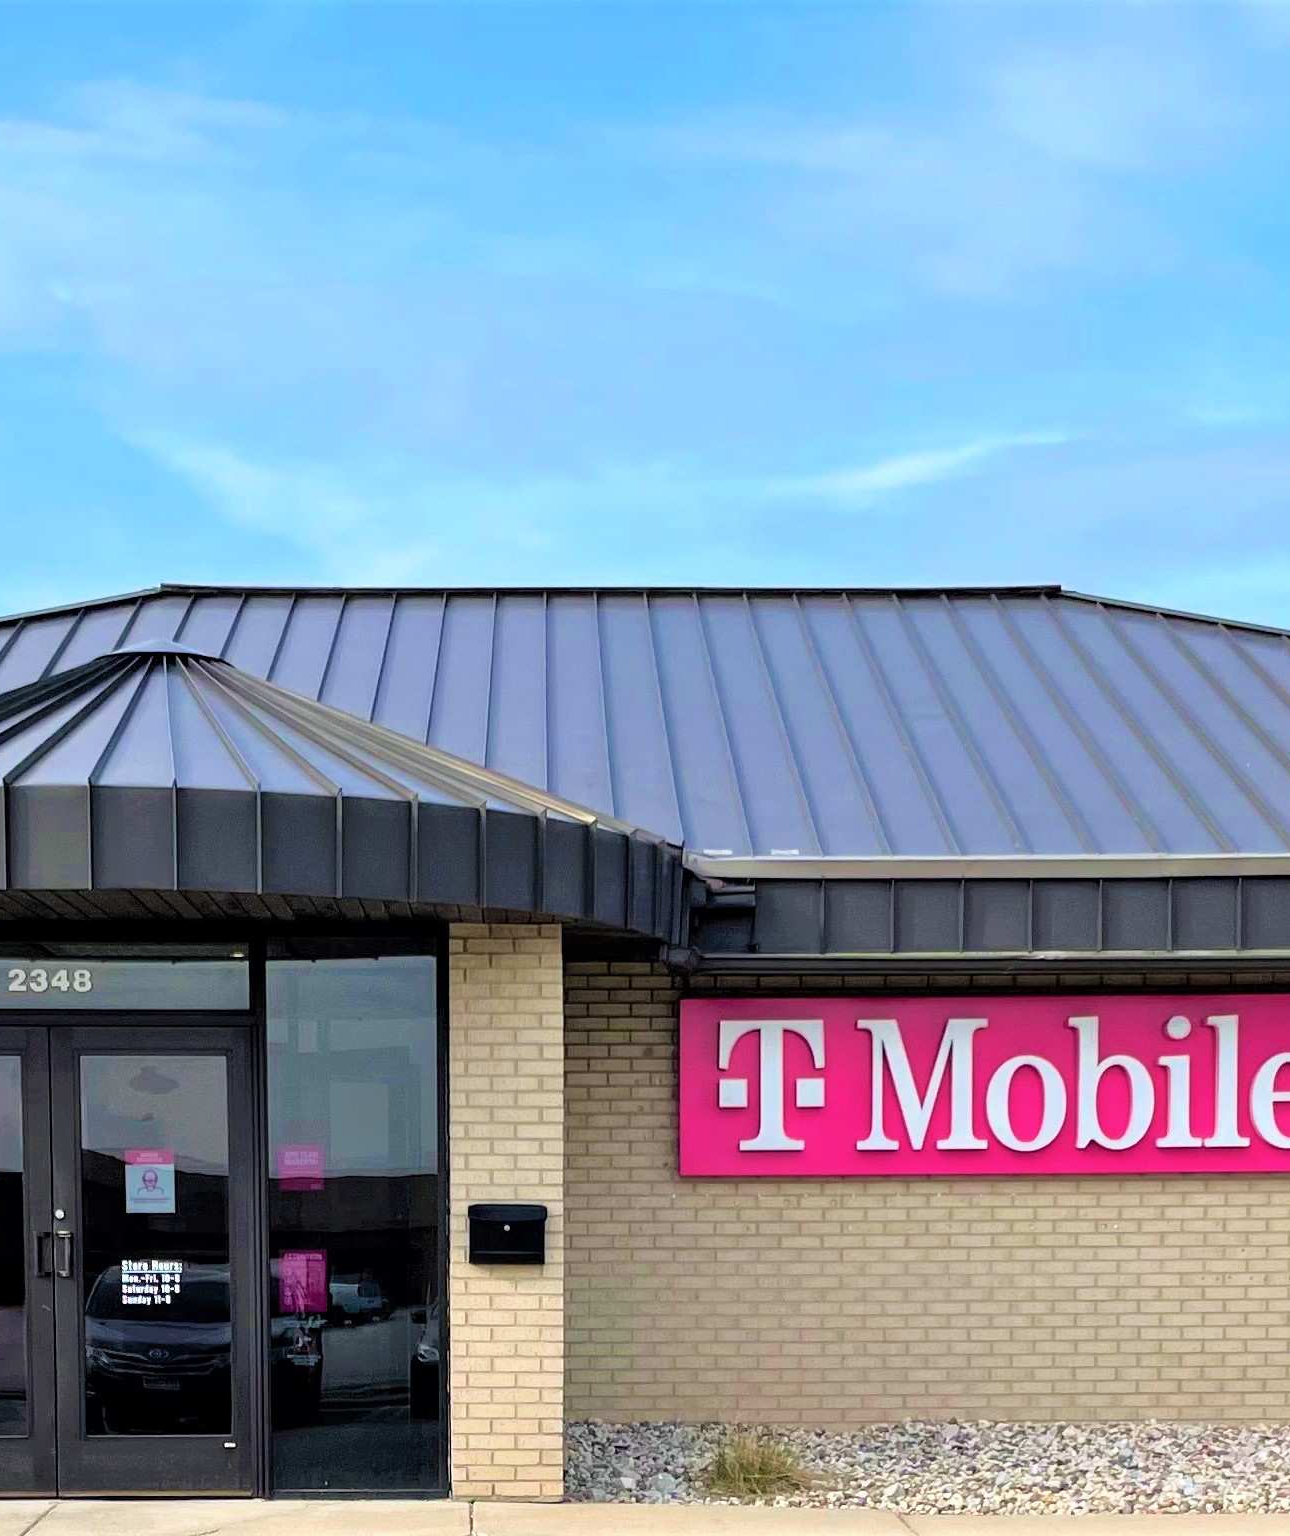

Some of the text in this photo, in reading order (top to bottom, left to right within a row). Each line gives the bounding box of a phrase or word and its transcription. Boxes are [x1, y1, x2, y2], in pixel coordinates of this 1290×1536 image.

[8, 968, 92, 993] 2348
[121, 1259, 149, 1271] Store
[121, 1284, 159, 1295] Saturday
[121, 1295, 151, 1305] Sunday
